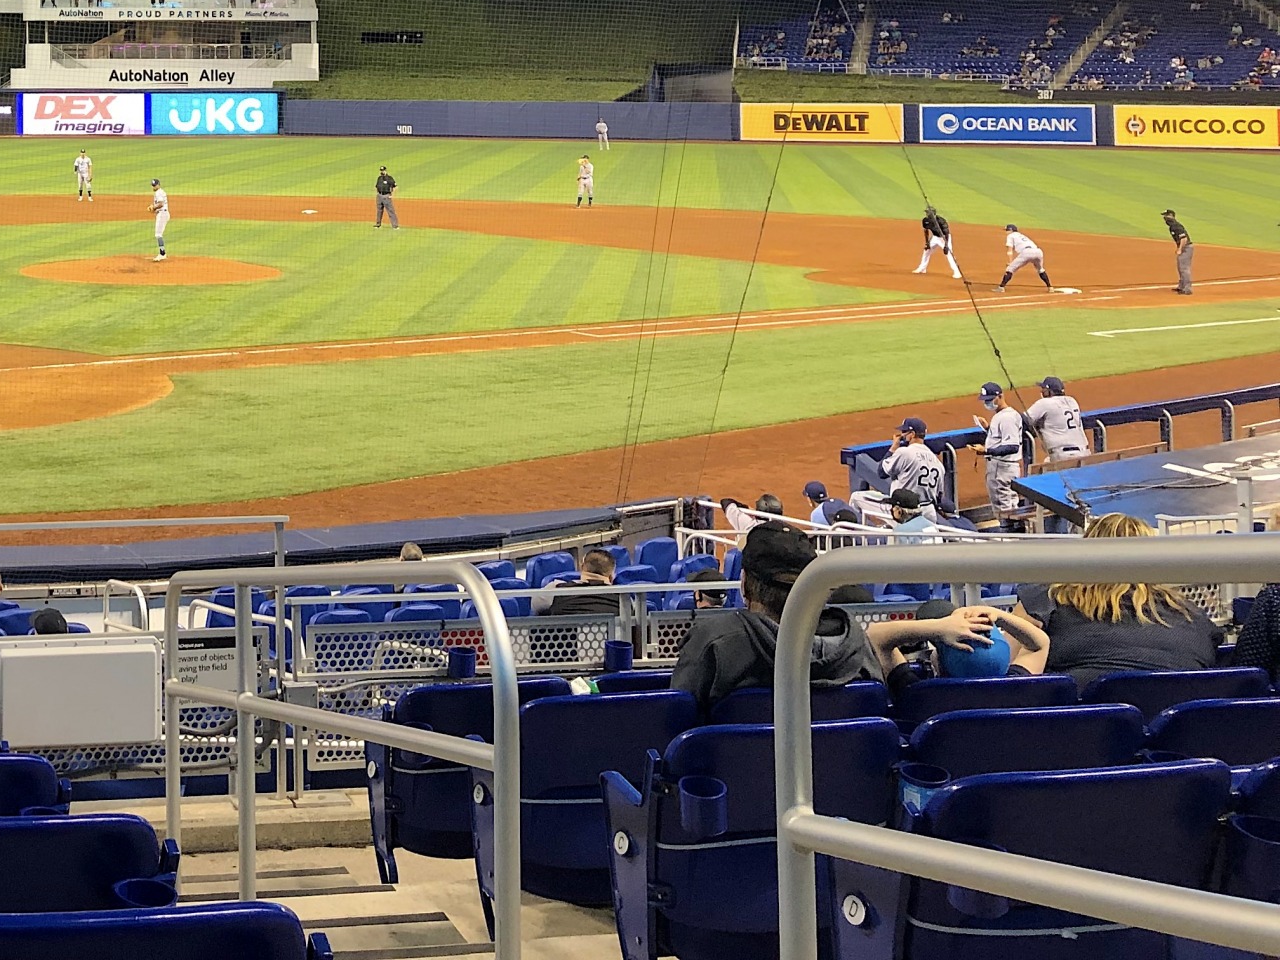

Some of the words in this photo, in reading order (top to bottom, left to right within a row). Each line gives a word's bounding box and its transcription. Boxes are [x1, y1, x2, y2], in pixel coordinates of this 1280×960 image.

[59, 9, 104, 19] AutoNation
[118, 10, 162, 18] PROUD
[169, 10, 234, 18] PARTNERS
[108, 70, 189, 84] AutoNation
[199, 69, 236, 85] Alley
[1037, 90, 1054, 100] 387
[33, 95, 118, 120] DEX
[54, 120, 125, 134] imaging
[396, 125, 413, 135] 400
[962, 117, 1023, 131] OCEAN
[1028, 118, 1078, 132] BANK
[1152, 119, 1266, 134] MICCO.CO
[918, 465, 939, 489] 23
[200, 653, 207, 661] of
[209, 653, 235, 663] objects
[199, 664, 211, 672] the
[212, 663, 228, 671] field
[181, 675, 198, 684] play!
[618, 836, 624, 849] C
[849, 900, 858, 918] D
